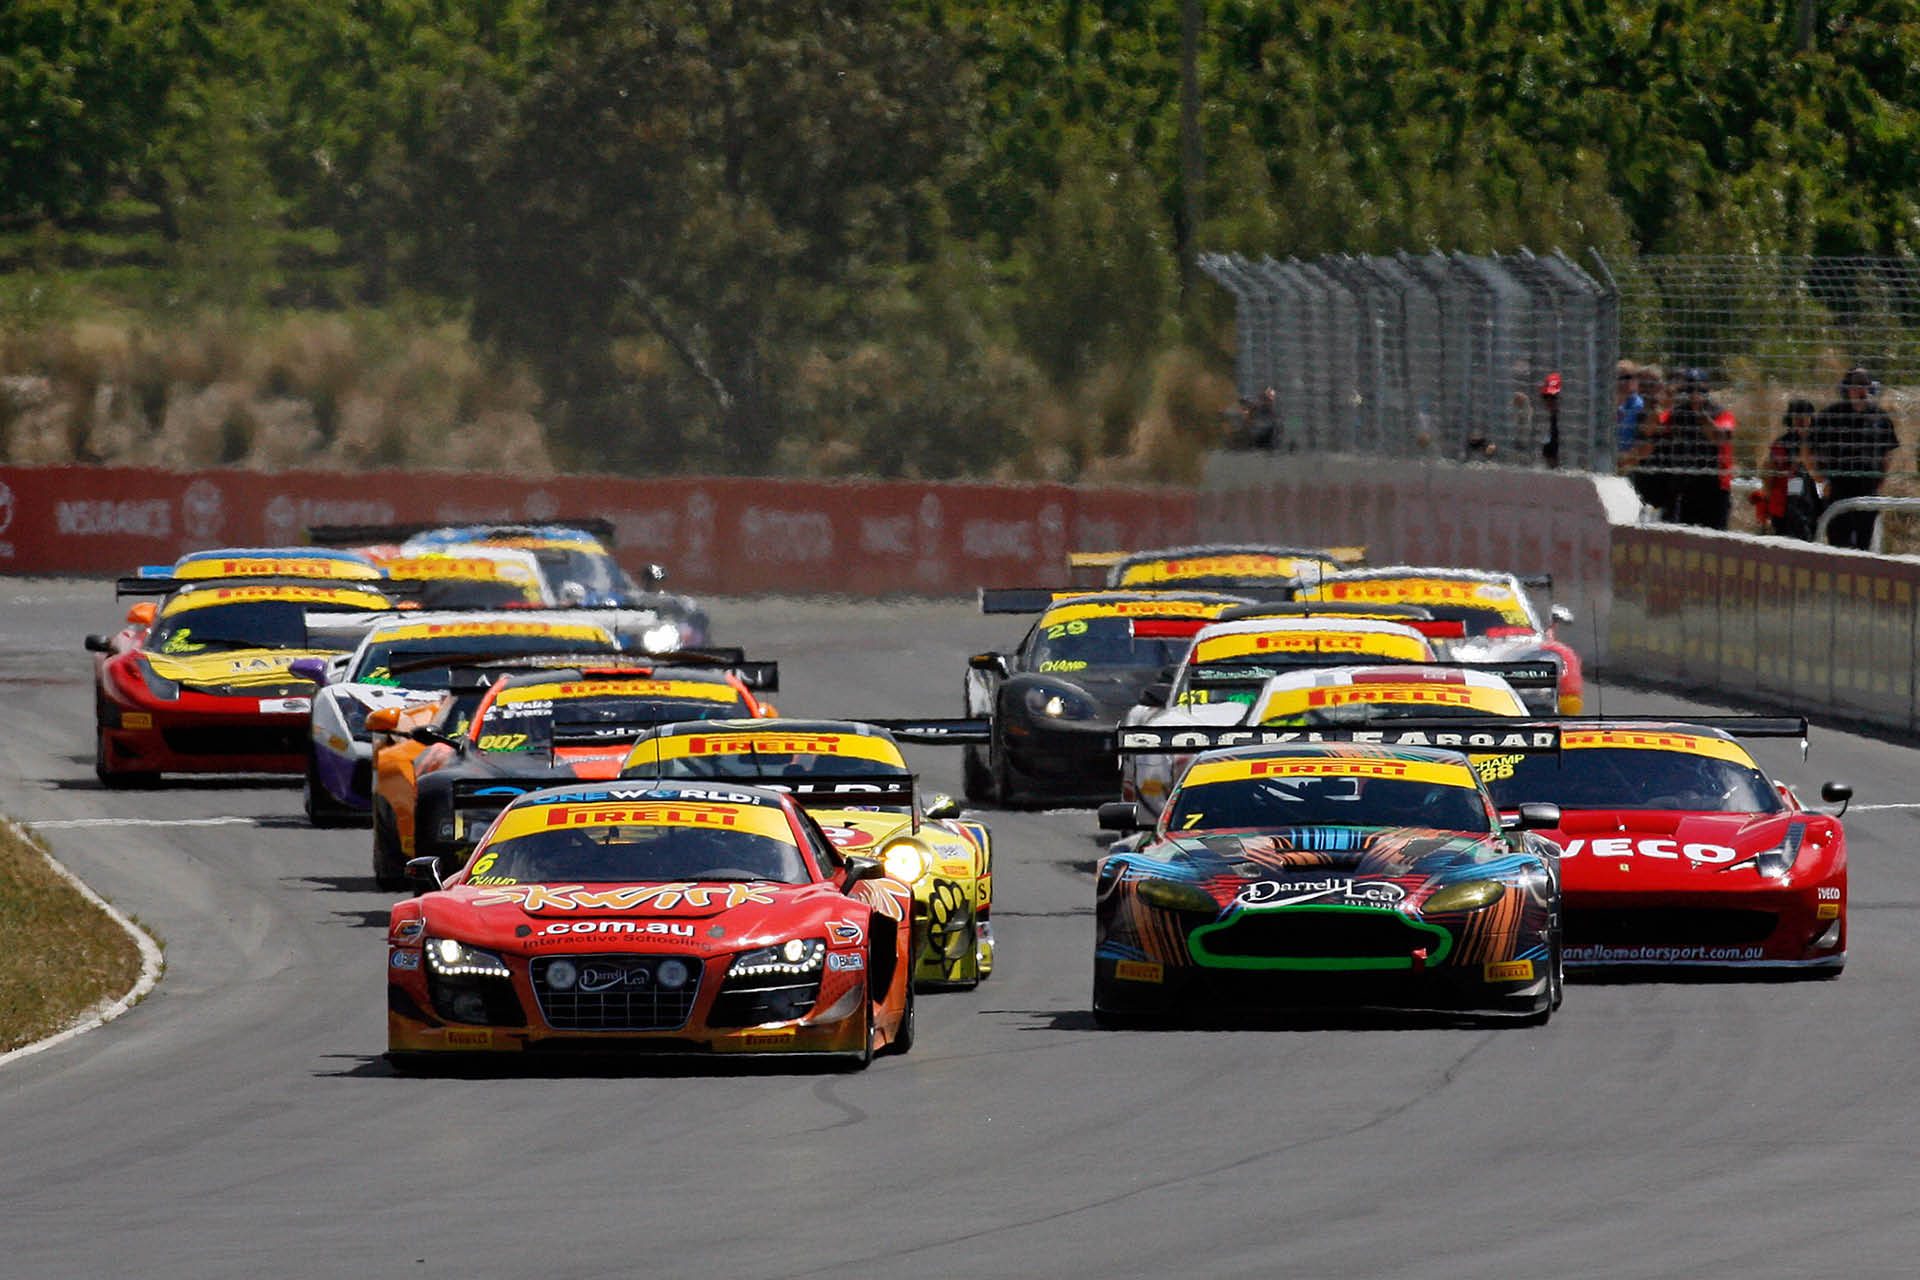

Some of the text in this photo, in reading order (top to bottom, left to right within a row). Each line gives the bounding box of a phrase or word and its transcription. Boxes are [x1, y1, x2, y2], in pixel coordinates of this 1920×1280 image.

[1047, 621, 1088, 640] 29
[1256, 635, 1362, 650] PIRELLI
[1308, 685, 1472, 706] PIRELLI
[478, 734, 528, 750] 007
[689, 733, 840, 753] PIRELLI
[1437, 733, 1555, 748] ROAD
[1250, 761, 1408, 776] PIRELLI
[1473, 754, 1525, 772] CHAMP
[1481, 764, 1515, 783] 88
[547, 803, 739, 826] PIRELLI
[1182, 814, 1203, 830] 7
[1560, 838, 1737, 864] VECO
[472, 853, 499, 875] 6
[1242, 878, 1400, 903] Darrell Lea
[1818, 887, 1840, 899] IVECO
[537, 920, 696, 937] .com.au
[523, 933, 711, 951] Interactive Schooling
[1561, 943, 1764, 961] anellomotorsport.com.au
